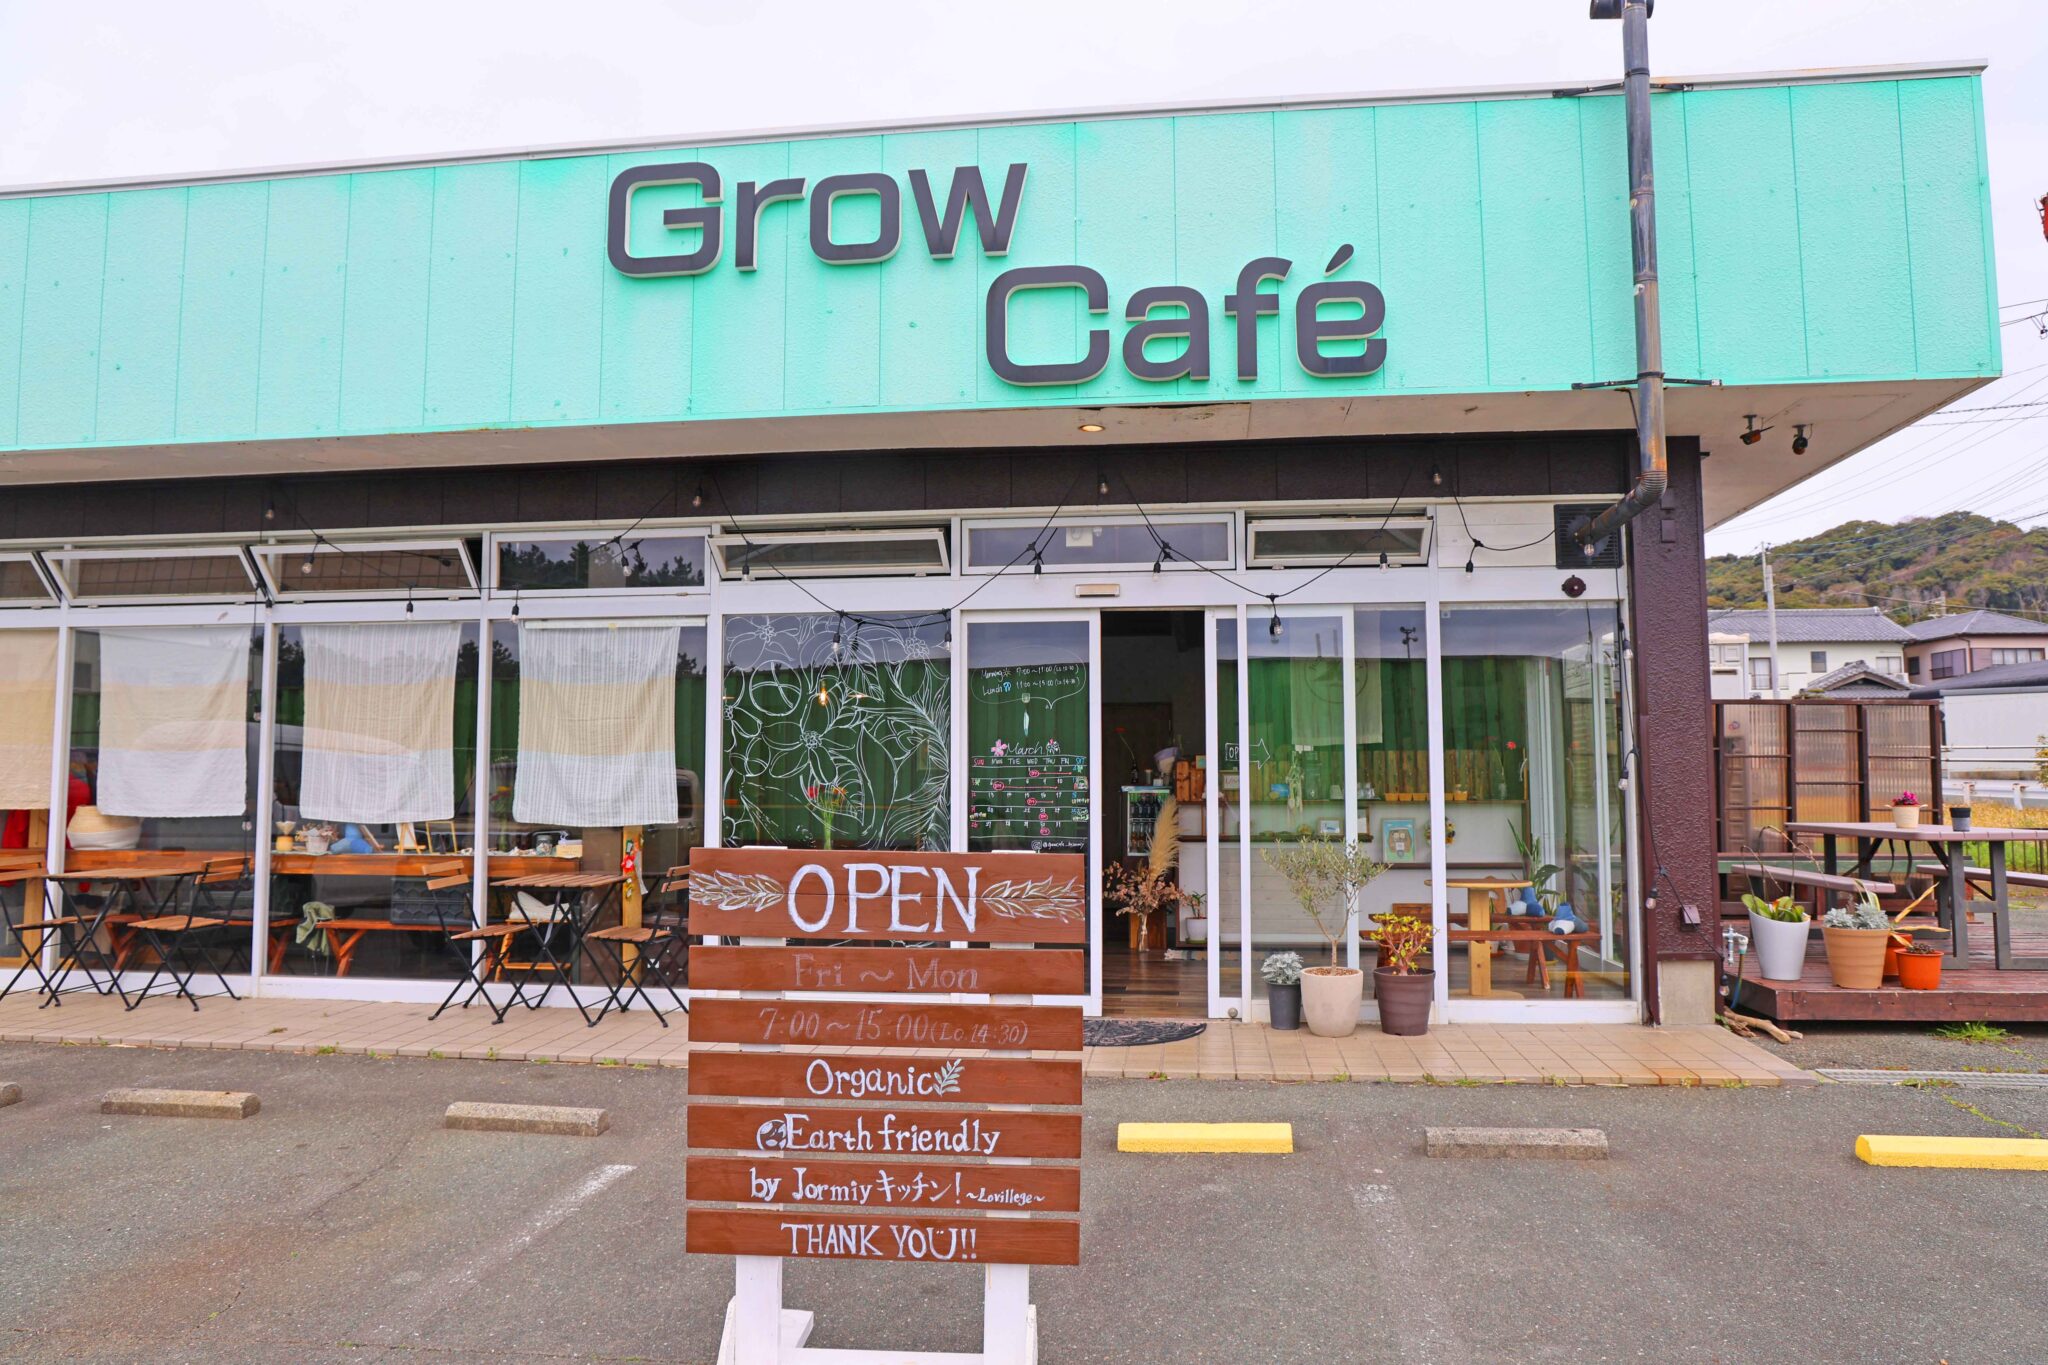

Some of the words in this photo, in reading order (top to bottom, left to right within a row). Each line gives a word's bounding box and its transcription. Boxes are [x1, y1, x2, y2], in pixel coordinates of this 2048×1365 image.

[607, 161, 1028, 278] Grow
[985, 243, 1388, 387] Café
[787, 863, 982, 933] OPEN
[792, 953, 842, 988] Fri
[906, 957, 978, 990] Mon
[805, 1058, 934, 1097] Organic
[784, 1113, 874, 1151] Earth
[877, 1113, 1001, 1155] friendly
[749, 1167, 782, 1201] by
[791, 1167, 873, 1205] Jormiy
[780, 1222, 884, 1256] THANK
